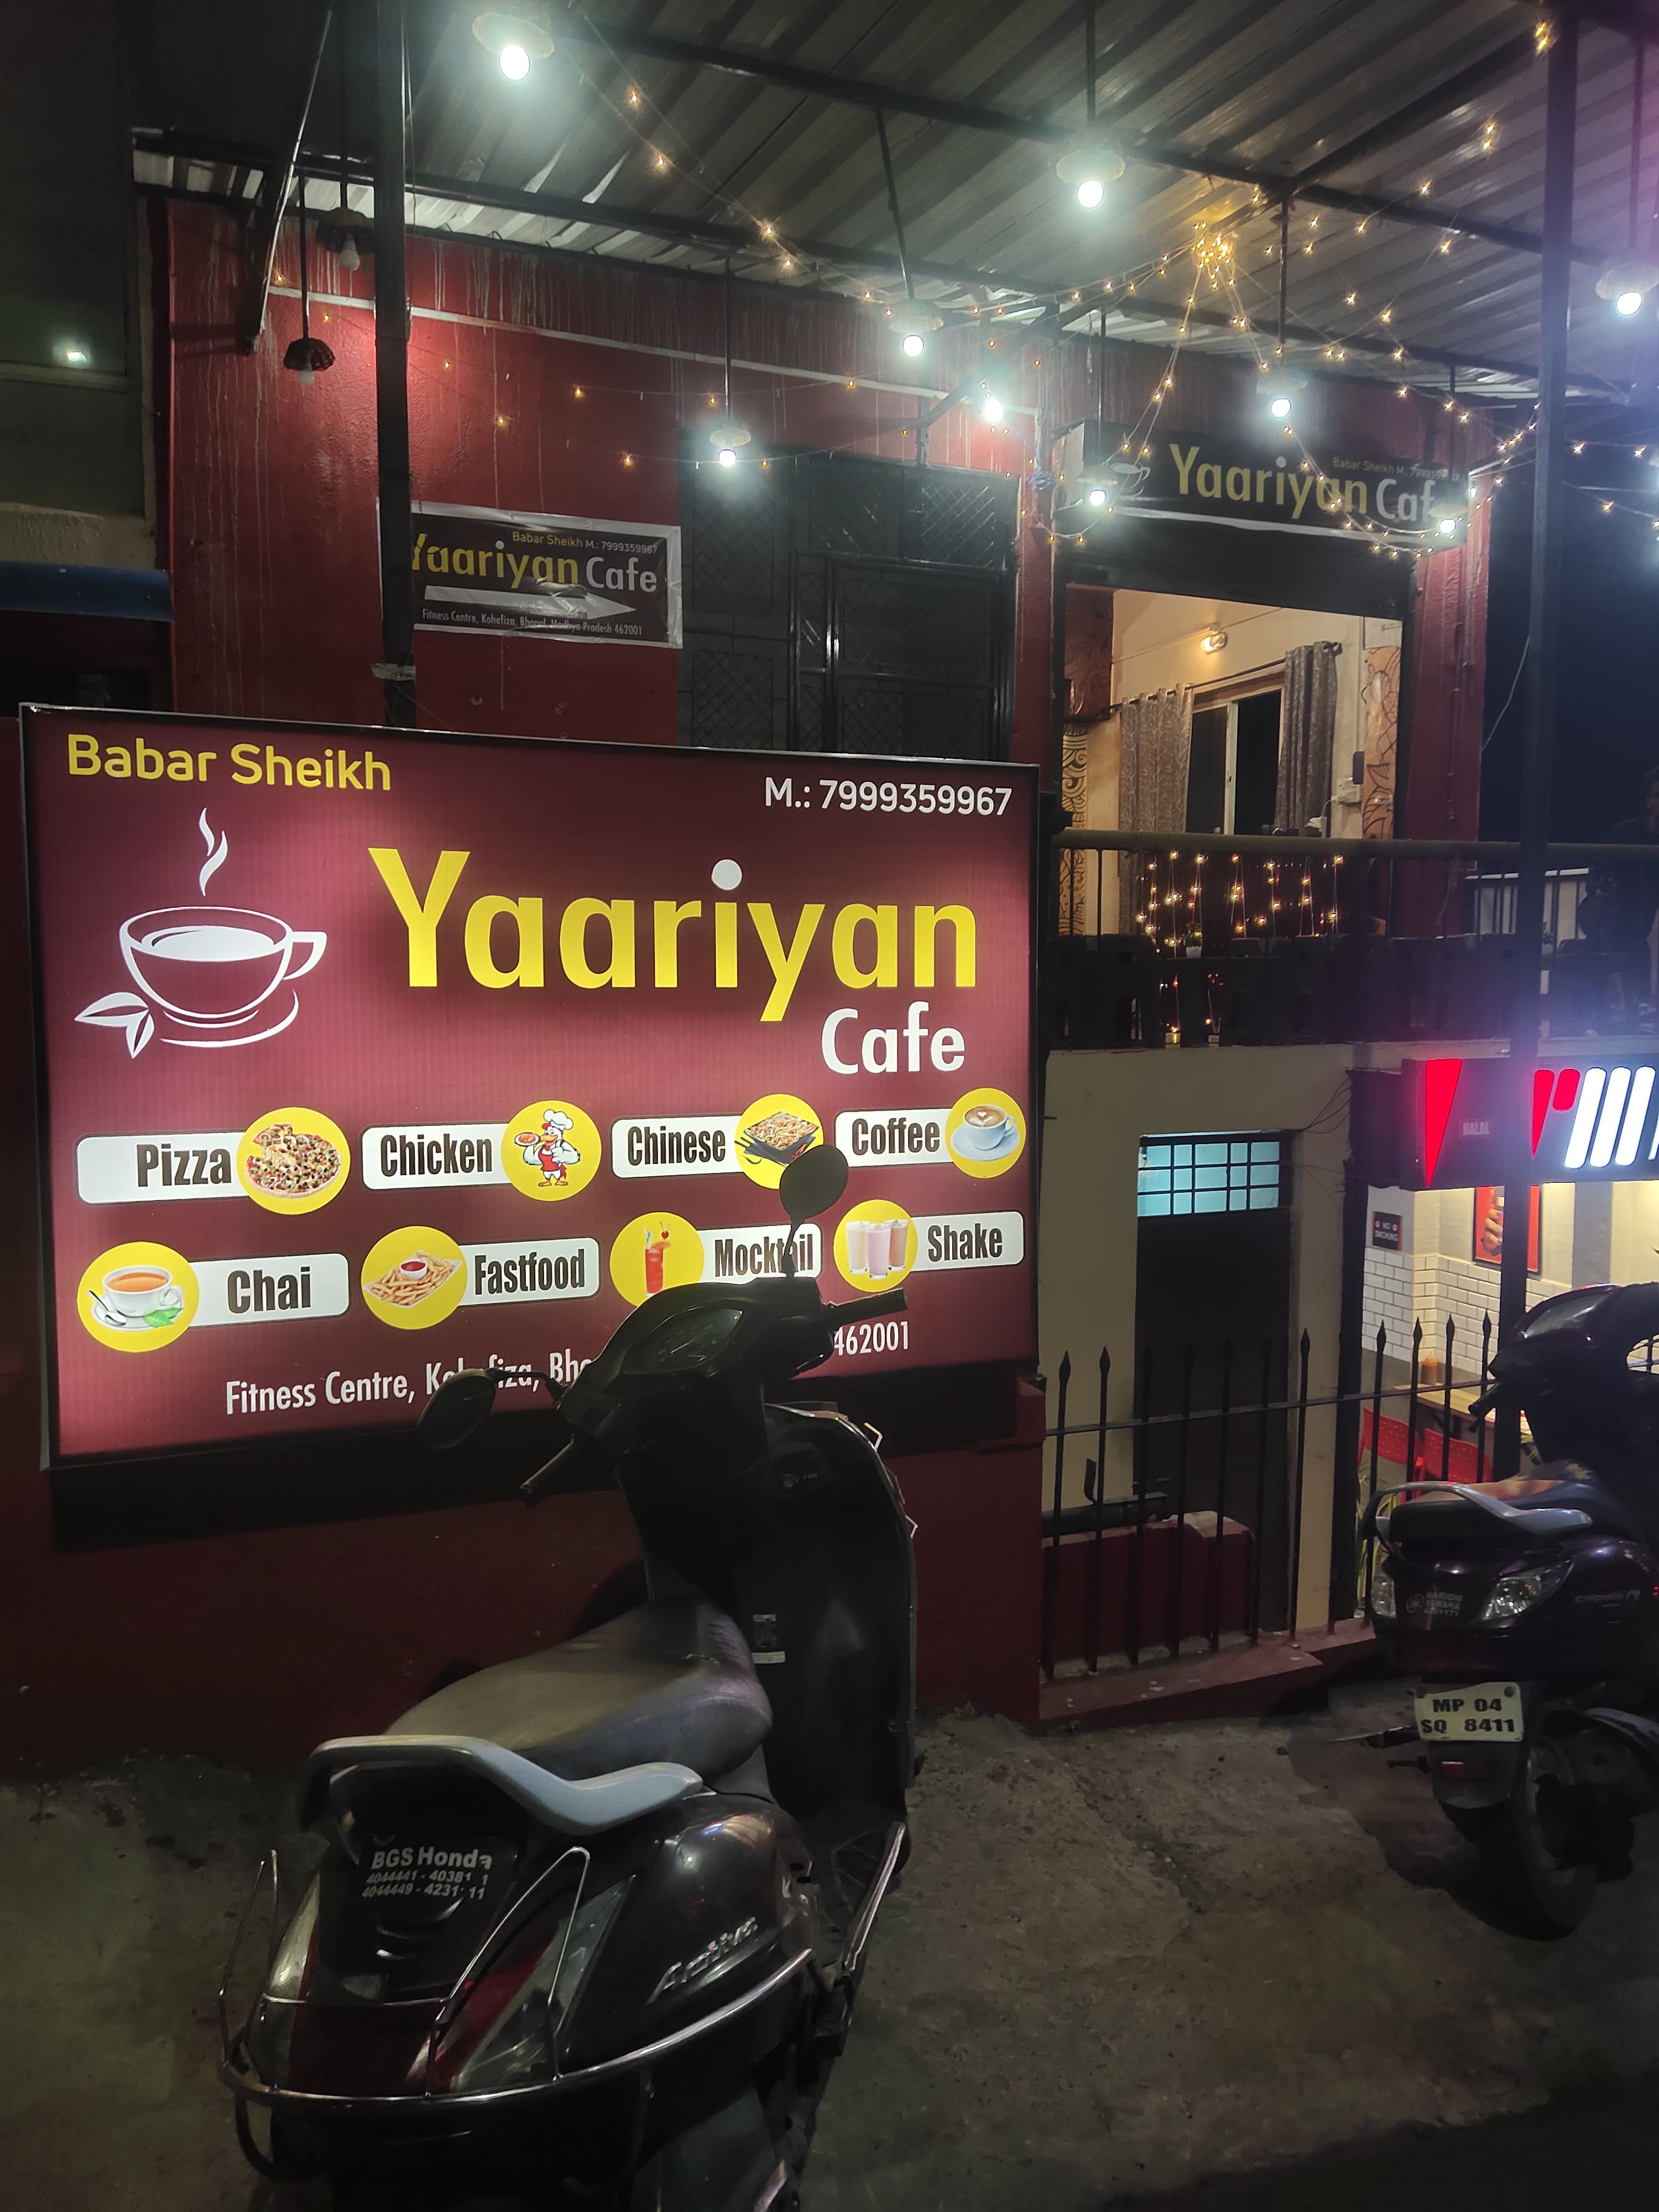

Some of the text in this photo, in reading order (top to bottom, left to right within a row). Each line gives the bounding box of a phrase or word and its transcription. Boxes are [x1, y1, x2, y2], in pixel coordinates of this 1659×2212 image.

[1170, 444, 1437, 521] Yaariyan Caf
[1333, 457, 1360, 469] Babar
[1363, 461, 1394, 473] Sheikh
[513, 531, 544, 544] Babar
[547, 535, 583, 548] Sheikh
[601, 541, 658, 555] 7999359967
[586, 556, 657, 592] Cafe
[422, 608, 449, 621] Fitness
[451, 611, 478, 625] Centre,
[582, 623, 612, 633] Pradesh
[614, 626, 642, 635] 462001
[68, 734, 391, 790] Babar Sheikh
[765, 777, 1013, 816] M.: 7999359967
[368, 847, 977, 1022] Yaariyan
[822, 1001, 966, 1074] Cafe
[627, 1125, 726, 1166] Chinese
[851, 1117, 941, 1156] Coffee
[1463, 1121, 1490, 1135] HALAL
[137, 1142, 232, 1187] Pizza
[380, 1133, 493, 1178] Chicken
[927, 1224, 1003, 1262] Shake
[1375, 1230, 1399, 1242] SMOKING
[1383, 1222, 1391, 1230] NO
[227, 1267, 311, 1314] Chai
[474, 1248, 586, 1296] Fastfood
[226, 1378, 316, 1415] Fitness
[325, 1372, 415, 1405] Centre,
[834, 1321, 909, 1356] 462001
[1433, 1698, 1502, 1713] MP 04
[1421, 1718, 1515, 1734] SQ 8411
[371, 1847, 414, 1870] BGS
[424, 1883, 486, 1900] 423111
